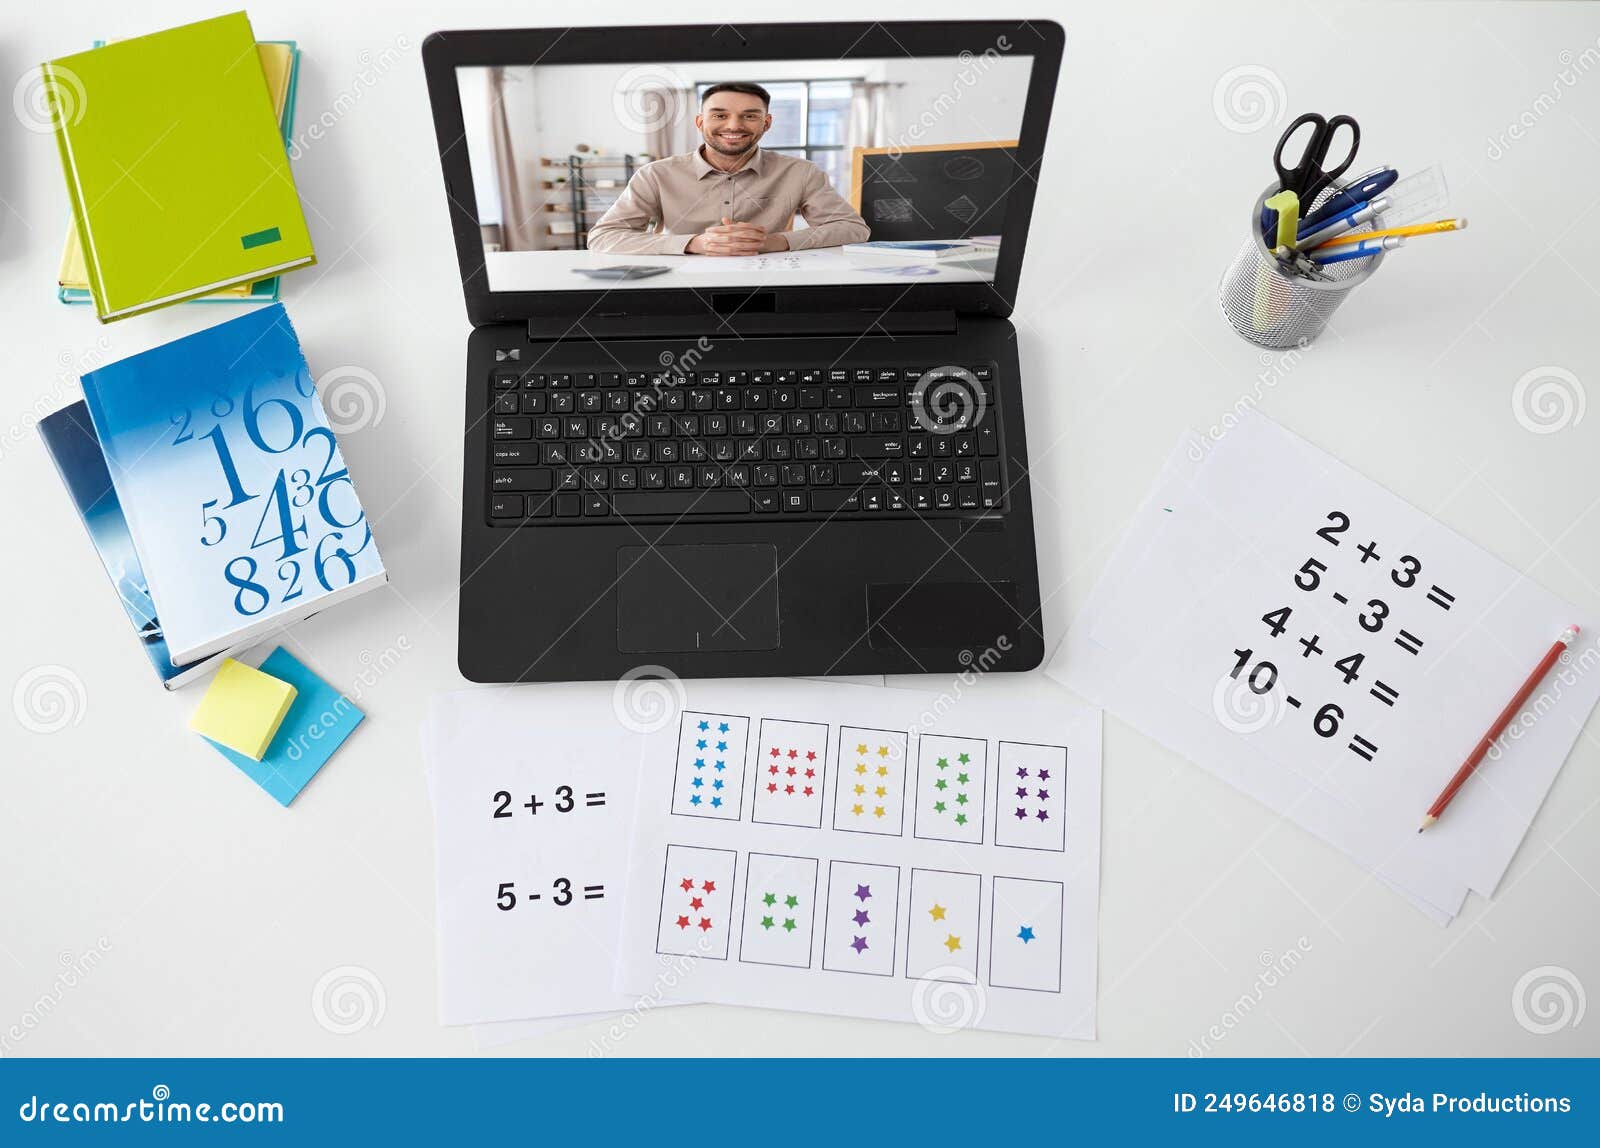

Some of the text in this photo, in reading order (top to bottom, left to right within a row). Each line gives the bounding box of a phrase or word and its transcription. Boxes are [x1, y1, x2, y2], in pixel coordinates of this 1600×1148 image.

[560, 398, 565, 406] 2
[587, 398, 593, 406] 3
[615, 397, 621, 405] 4
[643, 396, 648, 405] 5
[671, 396, 676, 404] 6
[698, 395, 704, 403] 7
[726, 395, 731, 403] 8
[753, 394, 759, 402] 9
[781, 393, 788, 402] 0
[532, 398, 537, 407] 1
[742, 420, 745, 428] I
[767, 419, 776, 428] O
[796, 419, 802, 427] P
[914, 416, 920, 424] 7
[937, 416, 943, 424] 8
[960, 416, 966, 424] 9
[170, 407, 194, 446] 2
[543, 423, 553, 432] Q
[571, 423, 581, 431] W
[601, 423, 607, 431] E
[628, 422, 635, 431] R
[657, 422, 662, 430] T
[684, 421, 691, 429] Y
[712, 421, 719, 429] U
[747, 445, 754, 454] K
[776, 445, 782, 453] L
[916, 441, 922, 450] 4
[939, 441, 945, 450] 5
[962, 441, 969, 449] 6
[551, 449, 558, 458] A
[580, 448, 586, 457] S
[607, 448, 615, 456] D
[636, 447, 642, 456] F
[663, 447, 672, 456] G
[691, 447, 699, 455] H
[721, 446, 726, 454] J
[302, 426, 349, 487] 2
[199, 423, 260, 510] 1
[964, 466, 970, 475] 3
[733, 472, 743, 480] M
[918, 467, 922, 476] 1
[941, 467, 947, 476] 2
[565, 475, 572, 483] Z
[594, 474, 601, 483] X
[621, 474, 629, 482] C
[650, 473, 657, 481] V
[678, 473, 685, 481] B
[291, 469, 314, 507] 3
[942, 493, 949, 502] 0
[250, 468, 308, 562] 4
[200, 499, 228, 546] 5
[1316, 511, 1455, 611] 2 + 3 =
[224, 556, 270, 615] 8
[278, 560, 303, 602] 2
[1294, 557, 1327, 591] 5
[1358, 599, 1390, 633] 3
[1394, 629, 1424, 656] =
[1261, 606, 1400, 707] 4 + 4 =
[1229, 648, 1279, 695] 10
[1313, 703, 1345, 738] 6
[1348, 733, 1378, 762] =
[493, 785, 606, 818] 2 + 3 =
[497, 882, 516, 911] 5
[553, 877, 573, 906] 3
[584, 885, 604, 900] =
